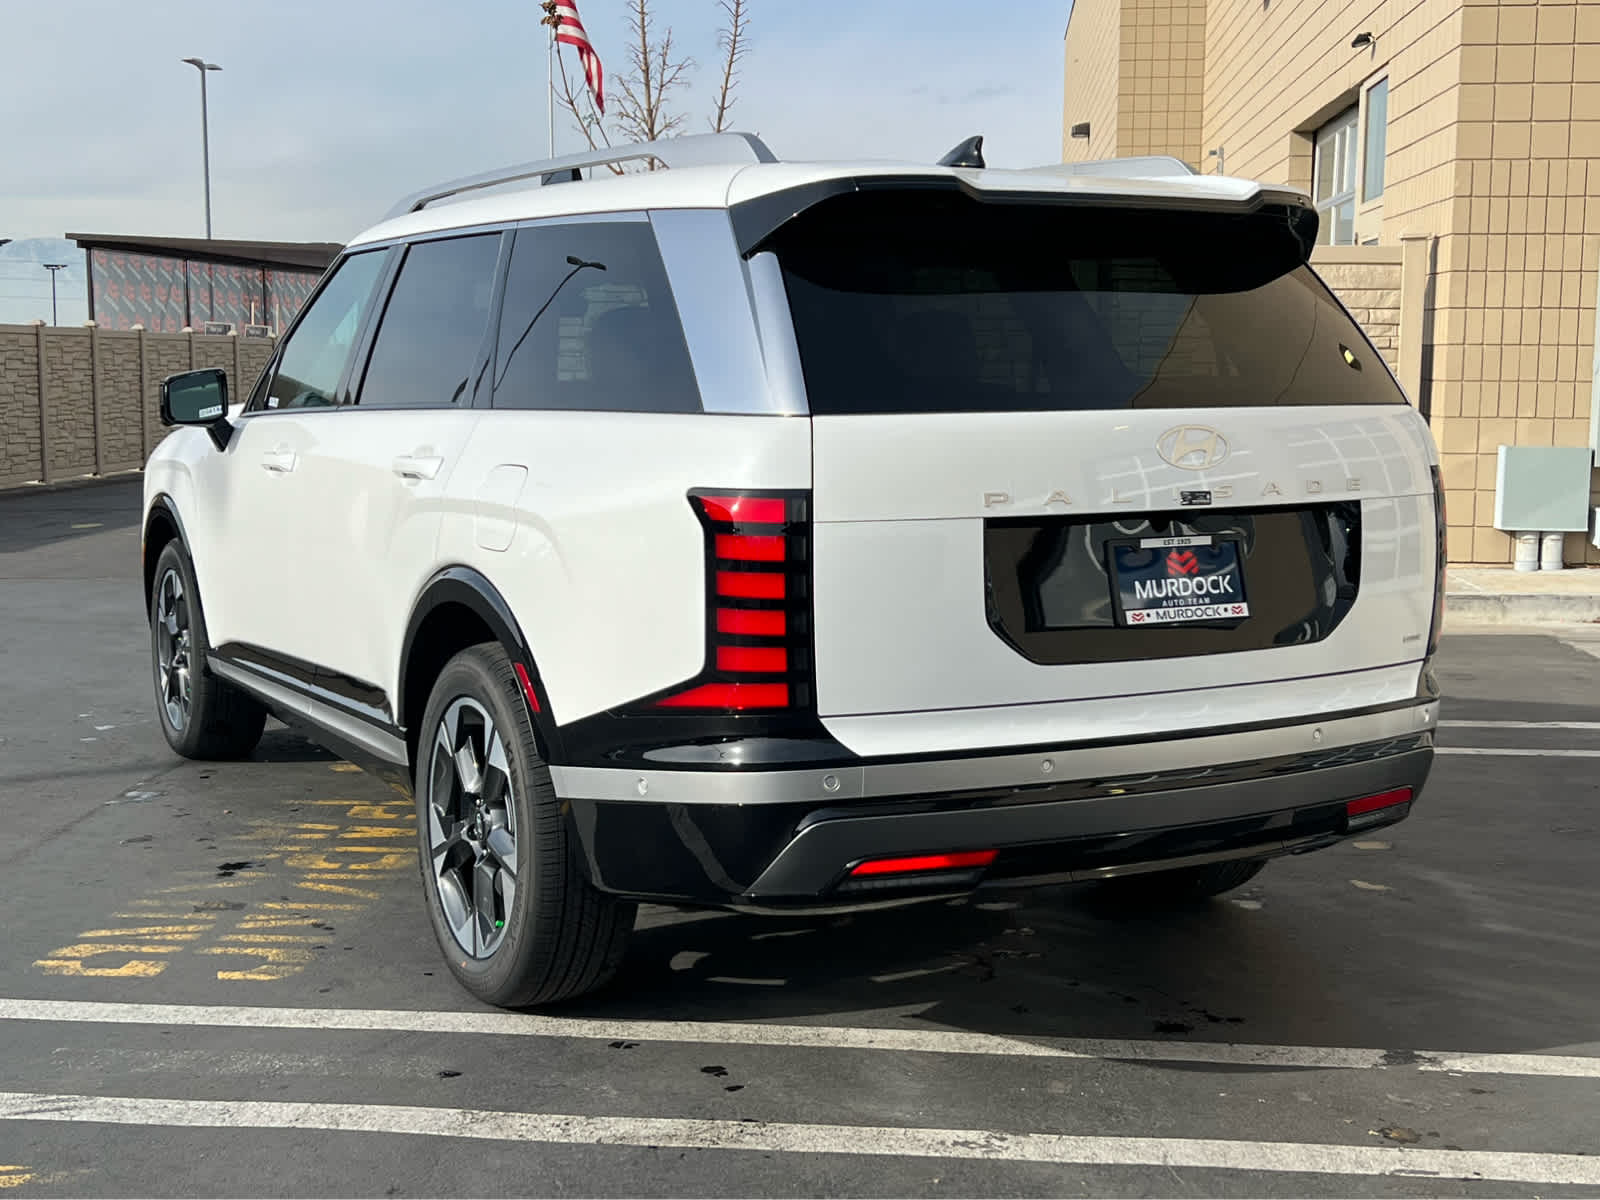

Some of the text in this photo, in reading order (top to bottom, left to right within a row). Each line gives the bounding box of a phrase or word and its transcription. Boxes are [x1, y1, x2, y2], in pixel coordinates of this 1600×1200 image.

[1134, 575, 1234, 600] MURDOCK
[1162, 597, 1211, 607] AUTO TEAM
[1155, 606, 1222, 621] MURDOCK
